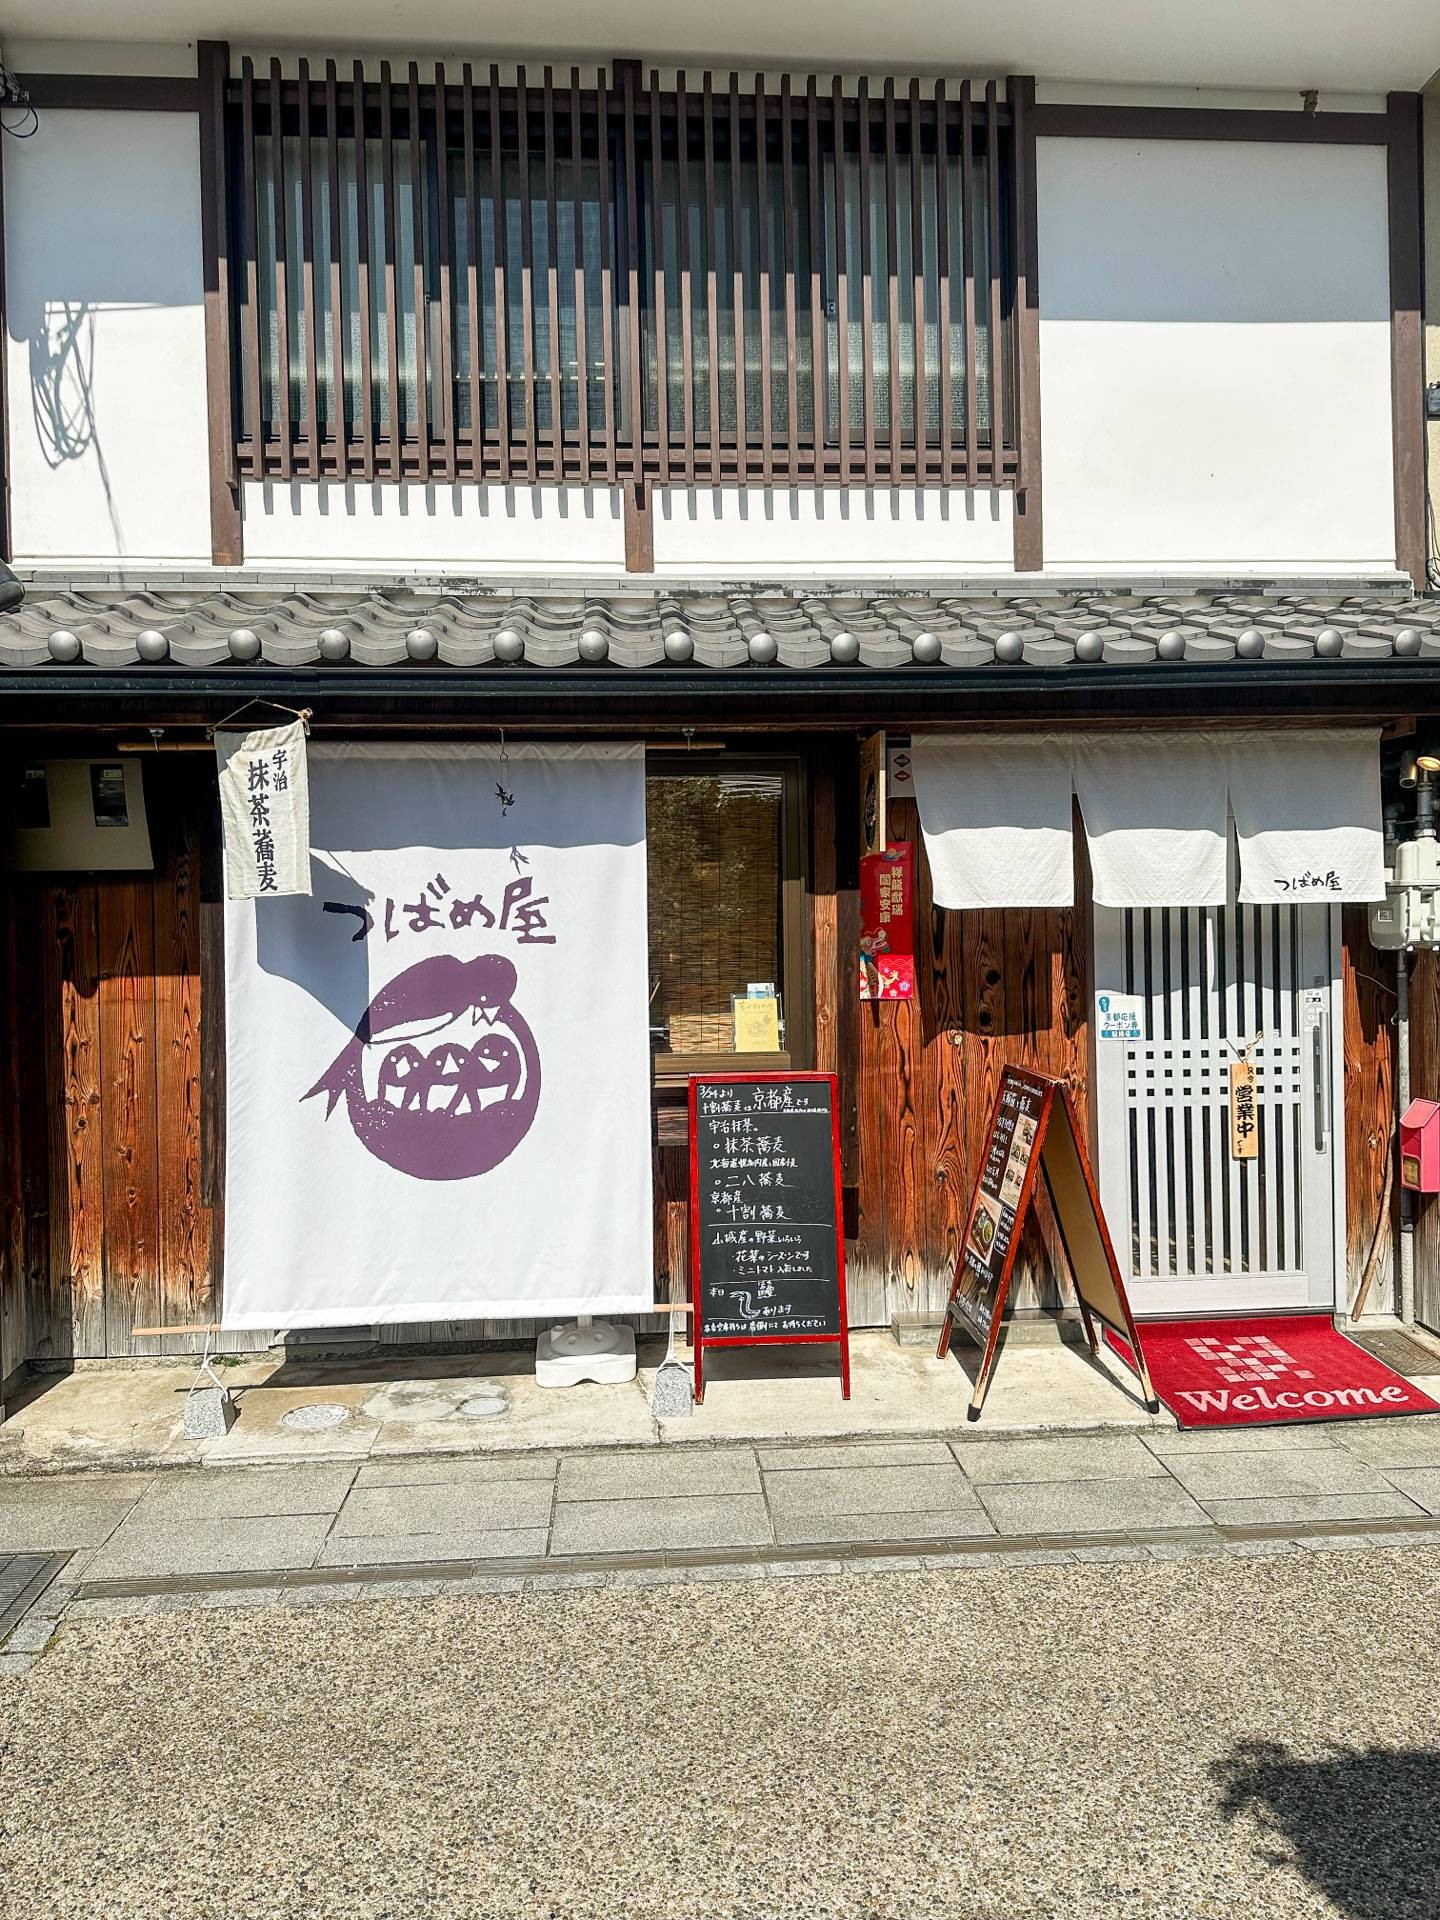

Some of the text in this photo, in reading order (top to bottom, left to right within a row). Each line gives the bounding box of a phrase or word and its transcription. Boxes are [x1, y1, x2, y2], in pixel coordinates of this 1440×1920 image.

[272, 748, 289, 791] 宇治
[247, 760, 278, 892] 抹茶蕎麦
[1273, 871, 1343, 891] つばめ屋
[322, 873, 557, 944] つばめ屋
[1235, 1084, 1255, 1138] 営業中
[1237, 1140, 1244, 1154] です
[709, 1190, 743, 1206] 京都産
[709, 1287, 725, 1298] 本日
[762, 1304, 792, 1316] あります
[1174, 1385, 1409, 1412] Welcome
